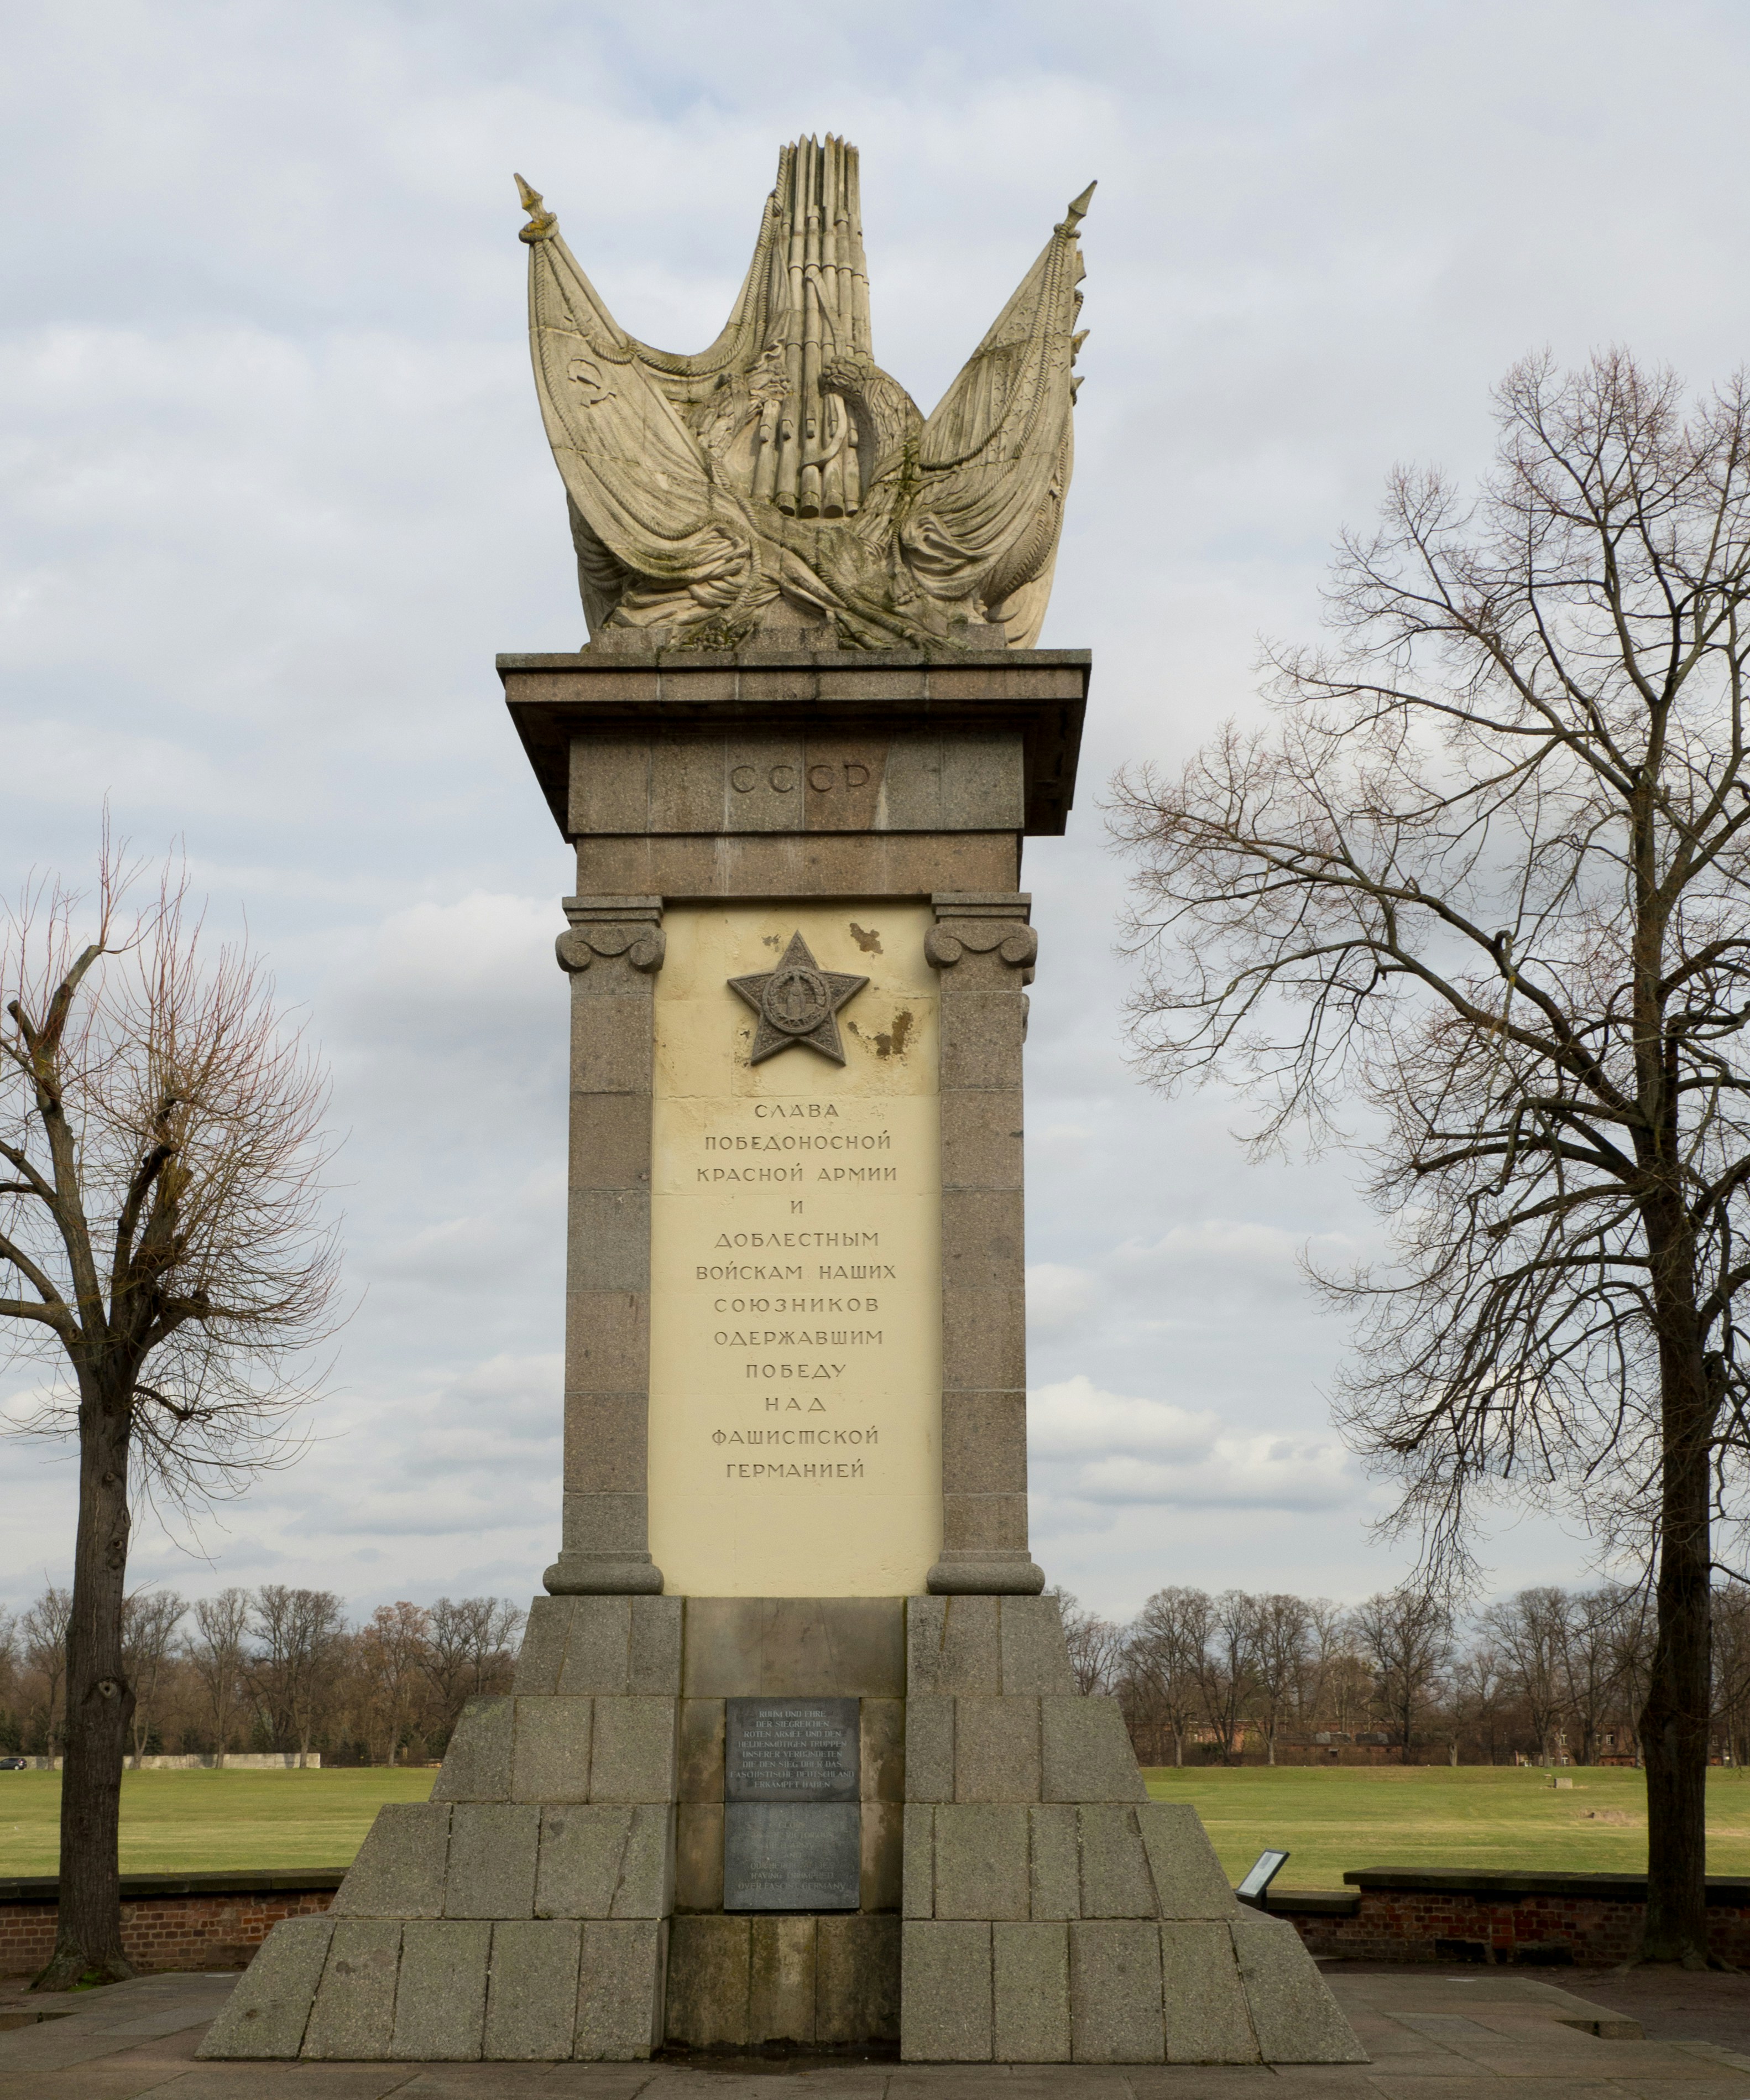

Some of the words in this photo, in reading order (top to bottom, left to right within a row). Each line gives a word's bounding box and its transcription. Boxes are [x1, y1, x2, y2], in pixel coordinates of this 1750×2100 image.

[754, 1103, 839, 1119] СЛАВА
[705, 1129, 891, 1151] ПОБЕДОНОСНОЙ
[697, 1162, 803, 1182] КРАСНОЙ
[817, 1167, 897, 1182] АРМИИ
[790, 1200, 803, 1214] И
[714, 1232, 879, 1249] ДОБЛЕСТНЫМ
[696, 1260, 802, 1280] ВОЙСКАМ
[819, 1265, 896, 1279] НАШИХ
[714, 1297, 879, 1313] СОЮЗНИКОВ
[714, 1330, 882, 1347] ОДЕРЖАВШИМ
[746, 1364, 847, 1380] ПОБЕДУ
[765, 1397, 827, 1413] НАД
[711, 1425, 879, 1446] ФАШИСТСКОЙ
[726, 1458, 864, 1478] ГЕРМАНИЕЙ
